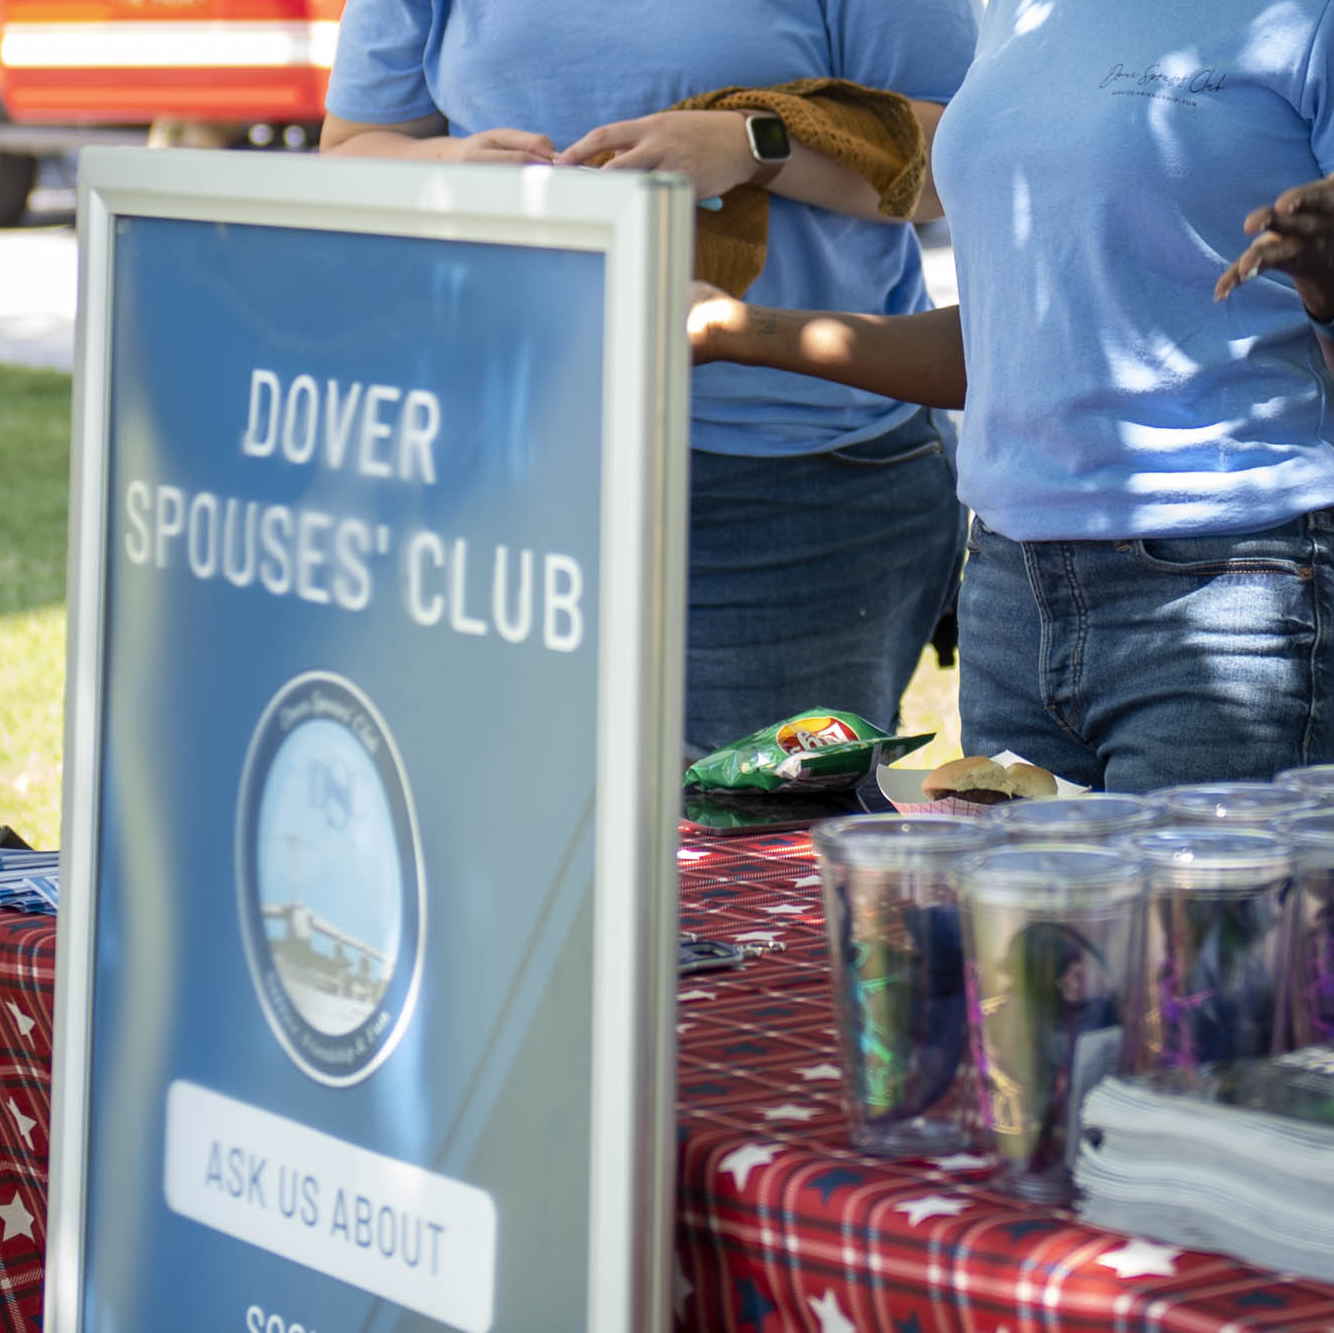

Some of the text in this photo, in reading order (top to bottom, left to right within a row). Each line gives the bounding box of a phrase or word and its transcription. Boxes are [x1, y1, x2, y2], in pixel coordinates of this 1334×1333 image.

[242, 368, 441, 486] DOVER
[125, 479, 584, 654] SPOUSES' CLUB
[204, 1140, 445, 1276] ASK US ABOUT
